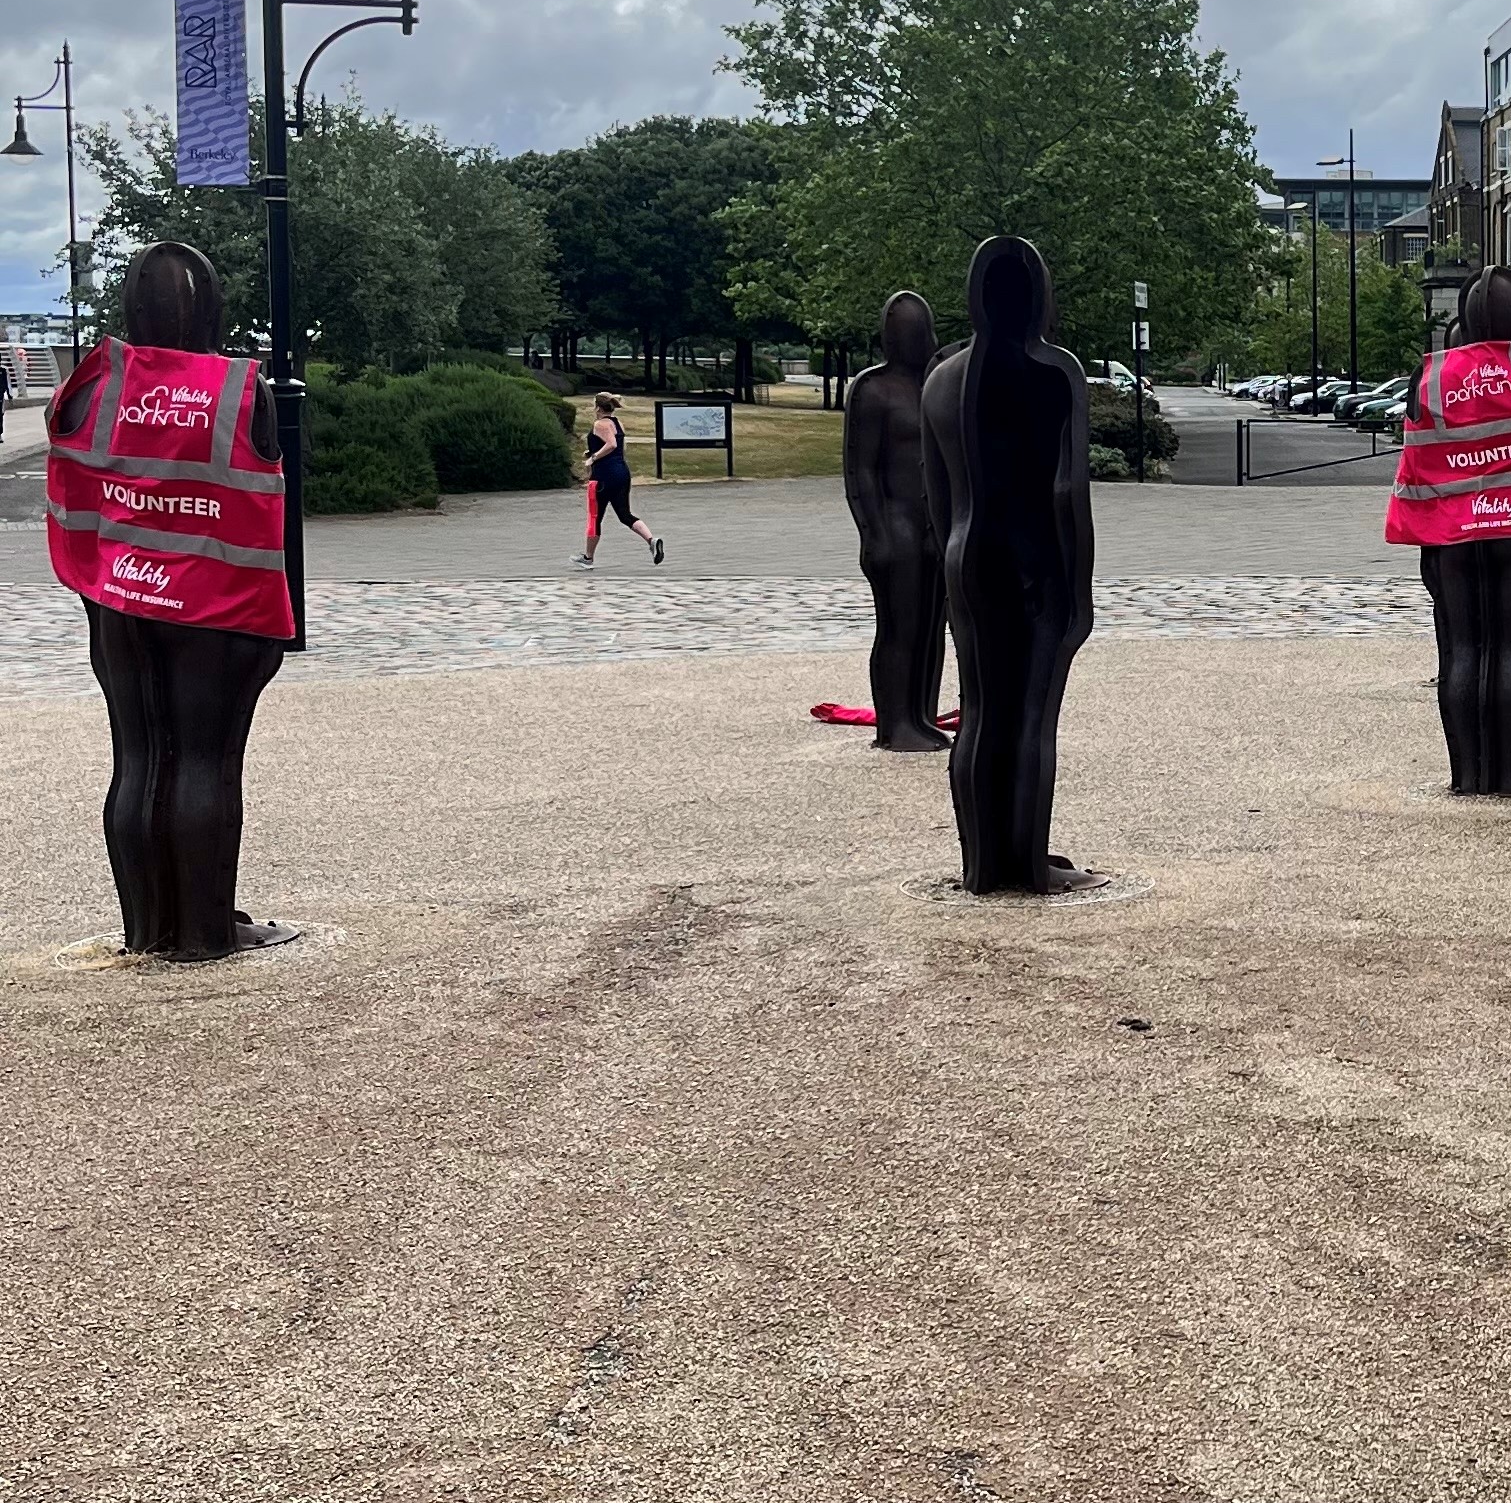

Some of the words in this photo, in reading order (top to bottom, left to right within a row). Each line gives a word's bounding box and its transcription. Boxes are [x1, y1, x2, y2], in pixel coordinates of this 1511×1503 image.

[190, 148, 236, 164] Berkeley
[171, 386, 212, 408] Vitality
[102, 481, 221, 519] VOLUNTEER
[112, 552, 171, 594] Vitality
